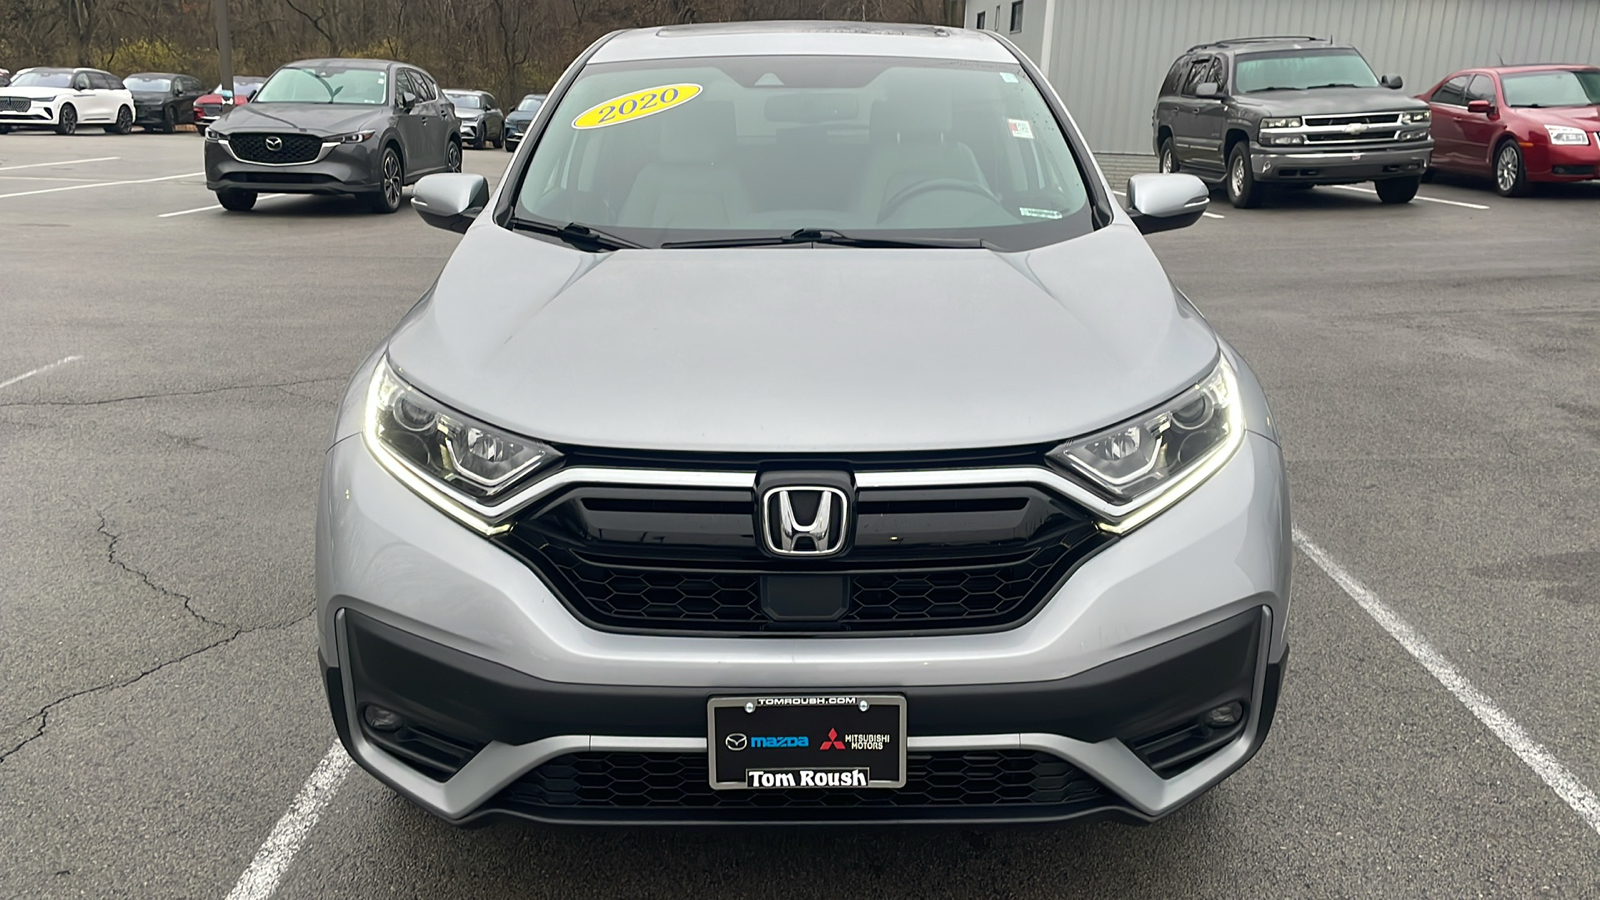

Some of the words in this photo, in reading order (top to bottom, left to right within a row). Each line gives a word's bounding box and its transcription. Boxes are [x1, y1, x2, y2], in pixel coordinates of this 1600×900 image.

[598, 88, 679, 123] 2020
[758, 697, 856, 705] TOMROUSH.COM
[845, 734, 890, 743] MITSUBISHI
[851, 742, 883, 750] MOTORS
[748, 771, 796, 787] Tom
[799, 769, 867, 787] Roush
